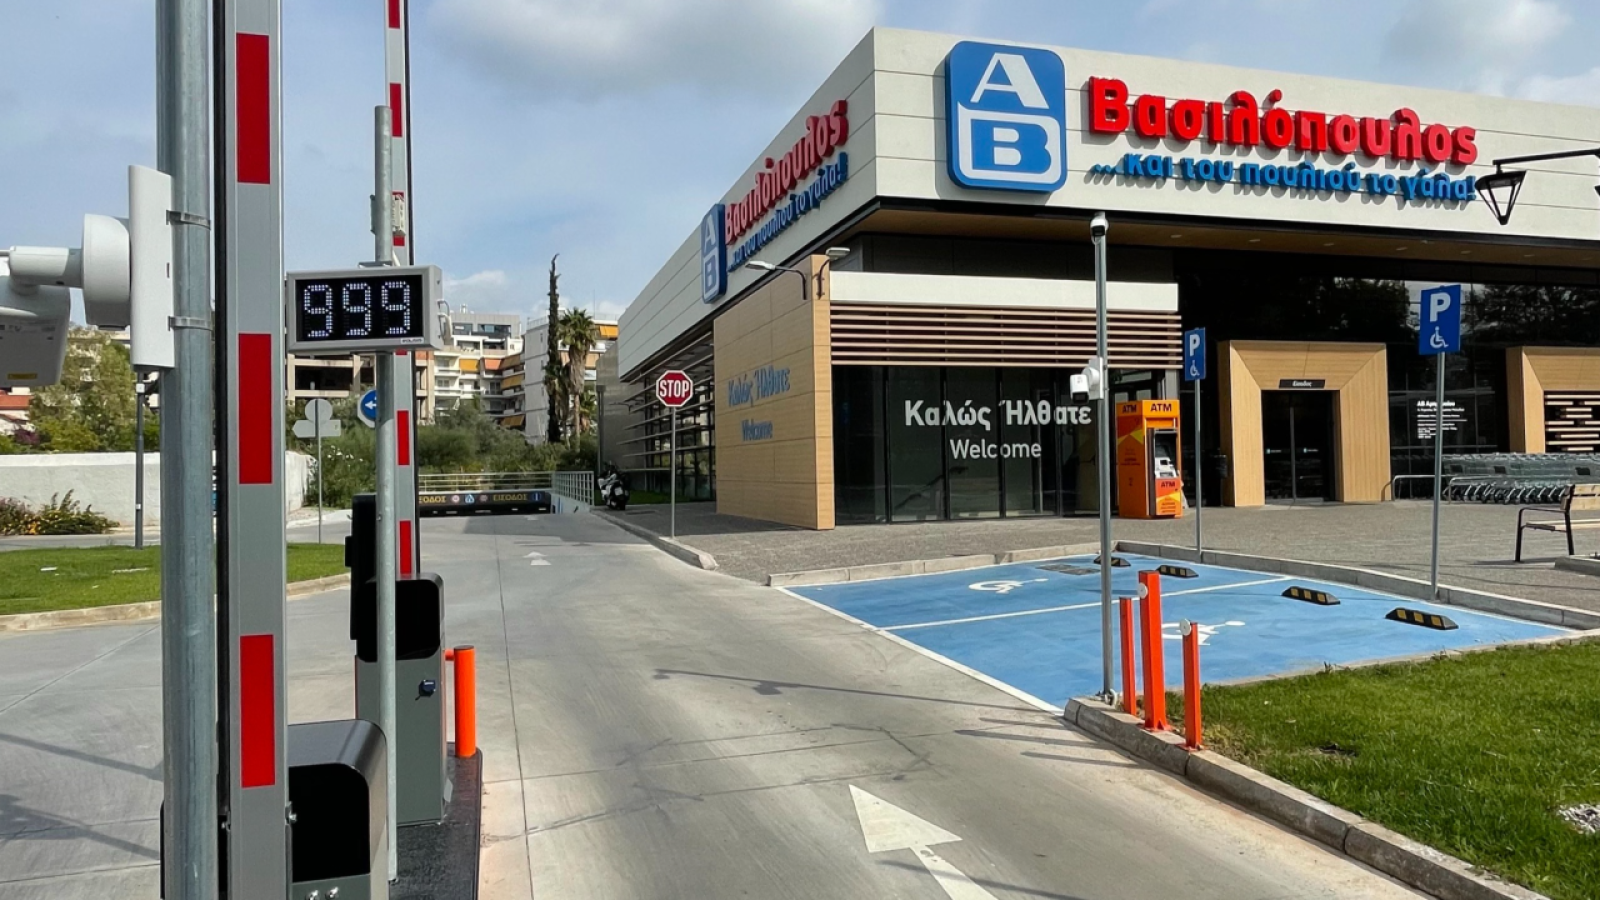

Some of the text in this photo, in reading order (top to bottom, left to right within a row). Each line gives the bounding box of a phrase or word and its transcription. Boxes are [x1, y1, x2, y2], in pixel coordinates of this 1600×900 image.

[1089, 76, 1478, 165] Βασιλόπουλος
[725, 99, 848, 245] Βασιλόπουλος
[1180, 157, 1234, 182] του
[1240, 160, 1361, 190] πουλιού
[1365, 172, 1398, 195] το
[1400, 168, 1477, 200] γάλα!
[304, 281, 410, 337] 999
[1430, 292, 1451, 322] P
[1190, 334, 1201, 356] P
[660, 379, 690, 398] STOP
[904, 400, 1092, 431] Καλώς Ήλθατε
[1122, 404, 1137, 414] ATM
[1150, 403, 1172, 412] ATM
[742, 418, 773, 441] Welcome
[950, 439, 1041, 459] Welcome
